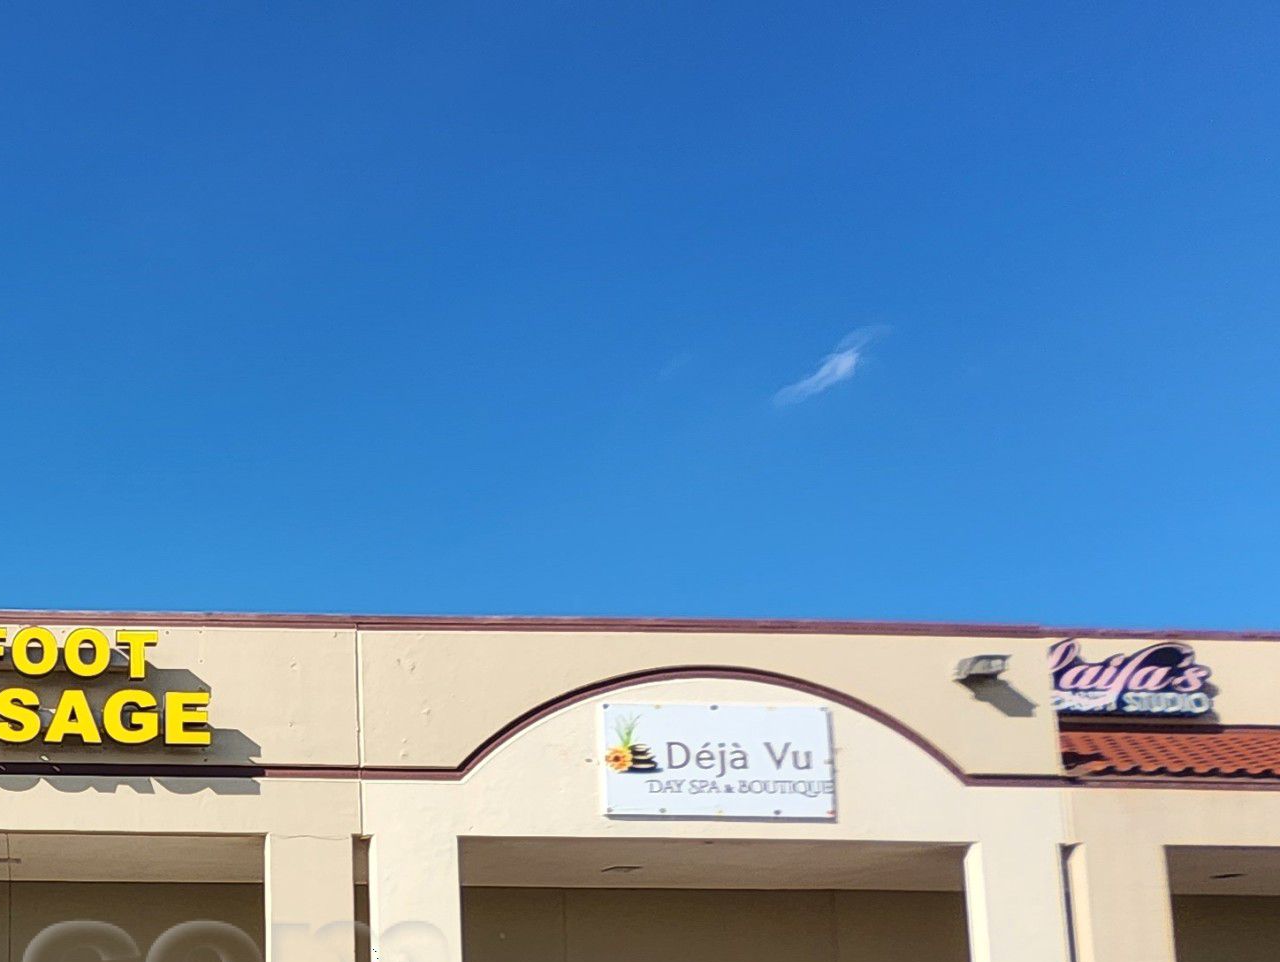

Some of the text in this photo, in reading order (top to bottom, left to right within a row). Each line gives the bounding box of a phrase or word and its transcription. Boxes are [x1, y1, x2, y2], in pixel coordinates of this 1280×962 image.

[1122, 692, 1211, 713] STUDIO
[666, 742, 813, 778] Déjà Vu
[646, 779, 836, 797] DAY SPA & BOUTIQUE
